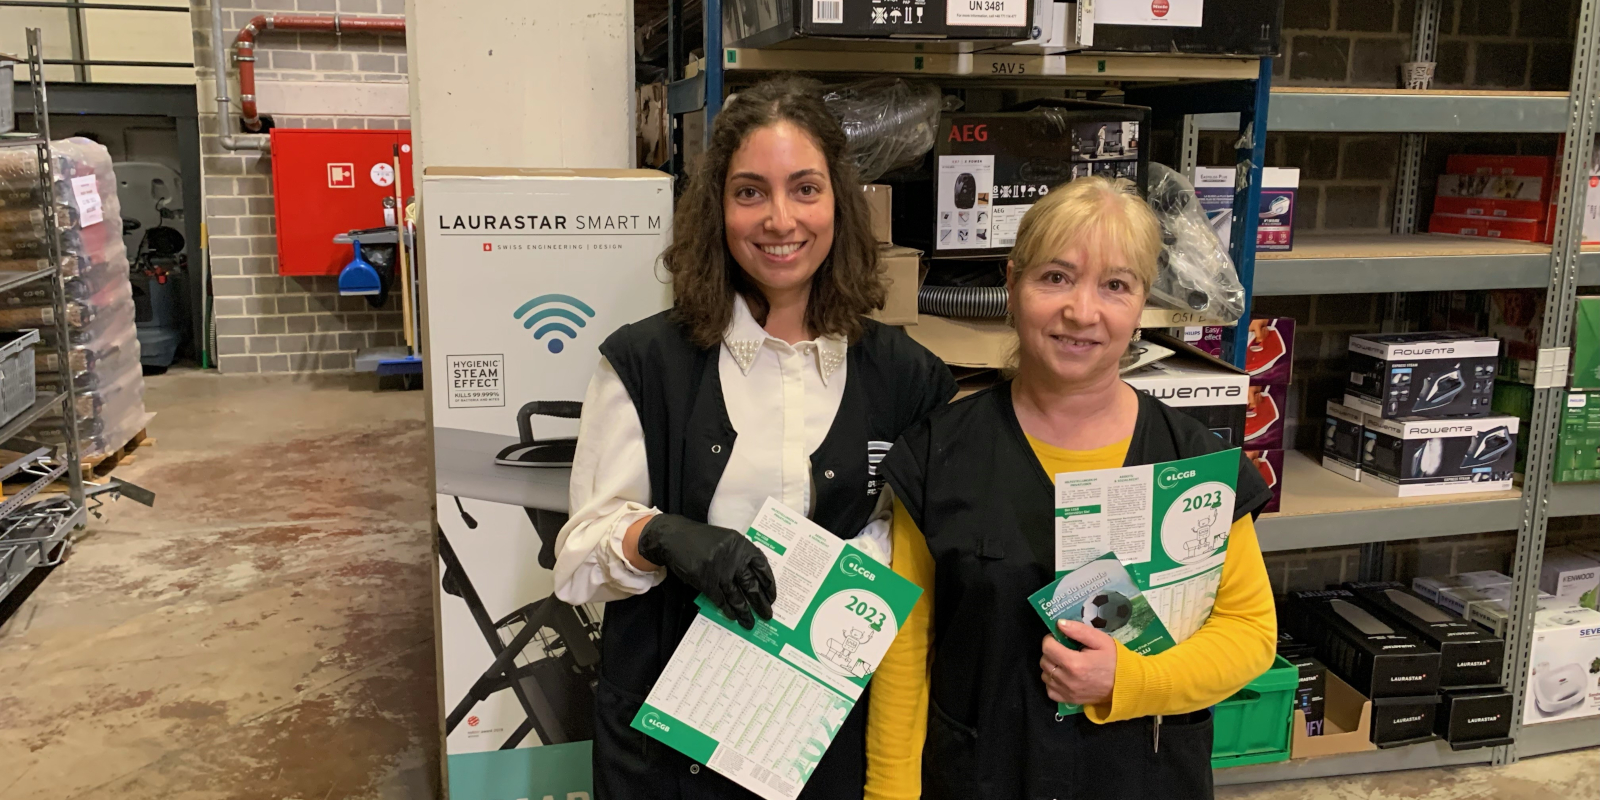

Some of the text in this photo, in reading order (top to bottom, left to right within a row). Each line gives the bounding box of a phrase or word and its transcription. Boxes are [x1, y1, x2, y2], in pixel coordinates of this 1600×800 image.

[969, 1, 1004, 12] UN 3481
[992, 62, 1025, 74] SAV 5
[948, 124, 988, 142] AEG
[440, 215, 660, 229] LAURASTAR SMART M
[454, 368, 498, 378] STEAM
[454, 379, 498, 388] EFFECT
[1172, 470, 1196, 481] LCGB
[1182, 490, 1222, 512] 2023
[853, 564, 876, 581] LCGB
[1041, 572, 1107, 610] Coupe du monde
[1045, 577, 1111, 616] Weltmeisterschaft
[844, 596, 886, 628] 2023
[1472, 610, 1497, 624] SEVERIN
[652, 718, 670, 732] LCGB
[1393, 716, 1421, 724] LAURASTAR
